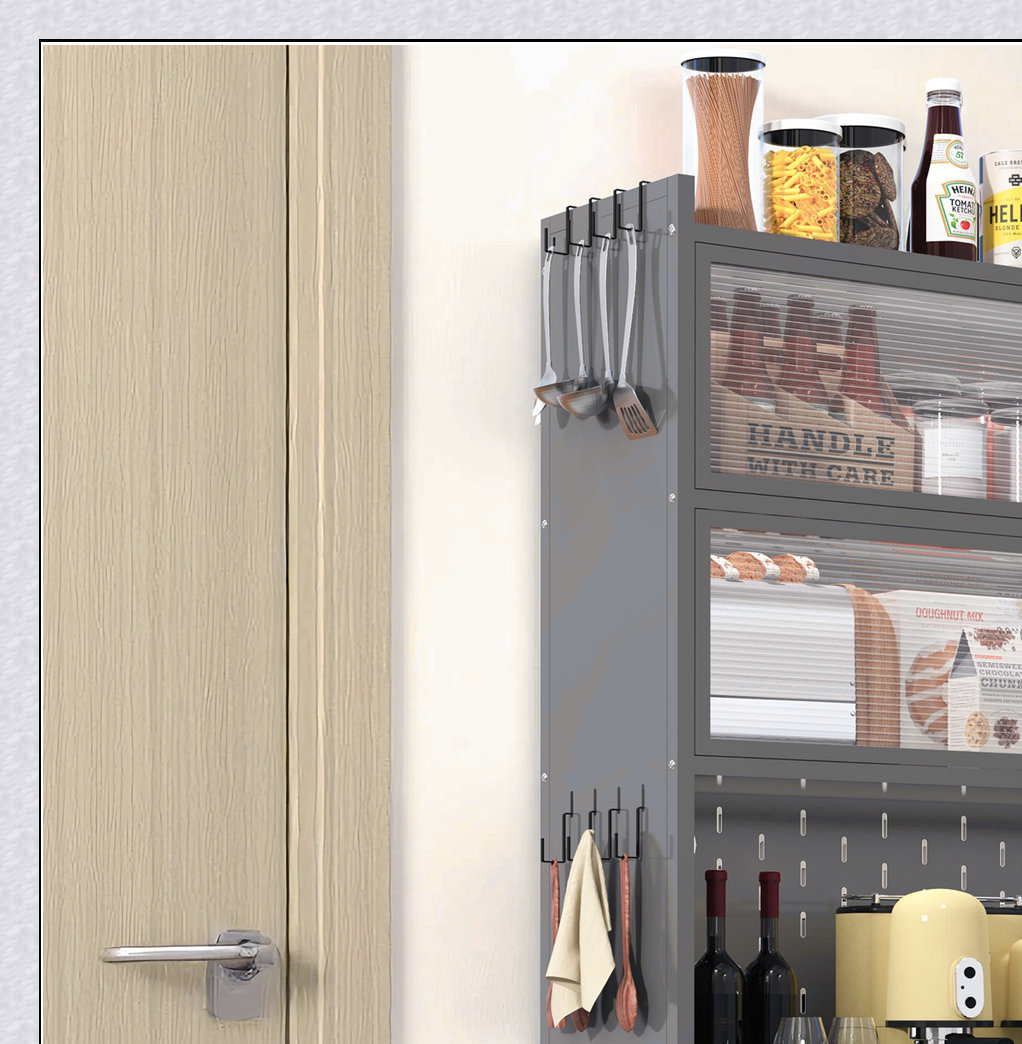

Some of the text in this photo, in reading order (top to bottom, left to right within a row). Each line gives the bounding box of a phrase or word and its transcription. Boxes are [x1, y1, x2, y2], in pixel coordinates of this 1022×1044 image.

[748, 423, 895, 458] HANDLE
[748, 457, 894, 486] WITH CARE
[916, 607, 984, 622] DOUGHNUT MIX
